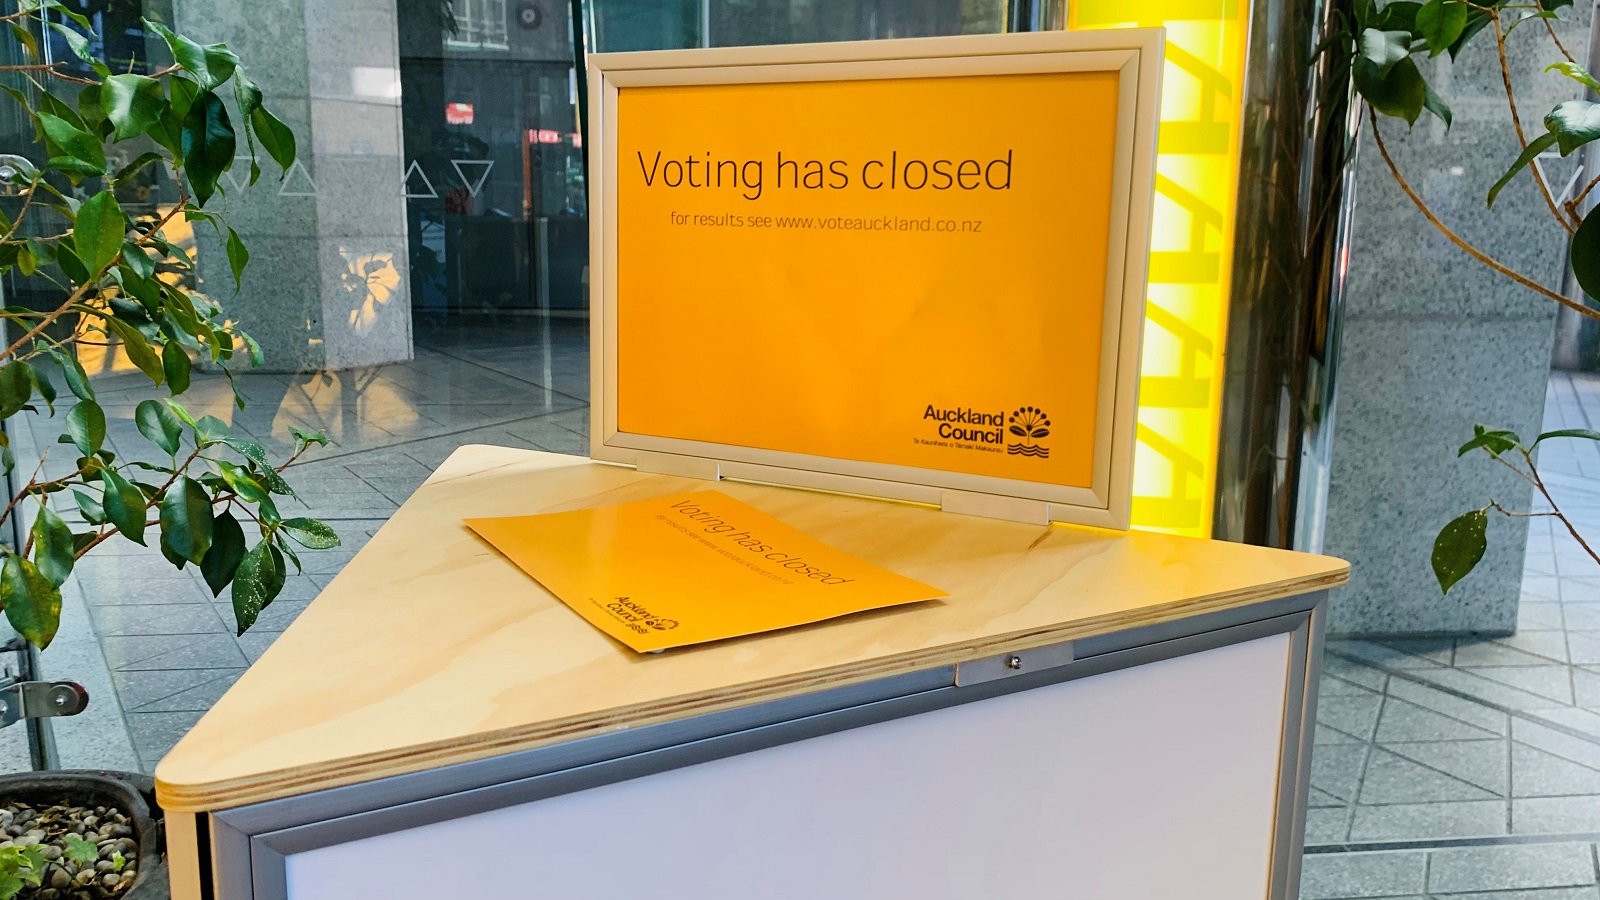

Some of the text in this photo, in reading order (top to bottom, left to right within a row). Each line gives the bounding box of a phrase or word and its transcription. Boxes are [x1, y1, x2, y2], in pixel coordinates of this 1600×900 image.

[637, 149, 1013, 201] Voting has closed
[670, 211, 982, 234] for results see www.voteauckland.co.nz
[923, 404, 1005, 427] Auckland
[938, 423, 1004, 444] Council
[671, 500, 856, 585] Voting has closed
[607, 603, 644, 623] Council
[614, 596, 660, 620] Auckland
